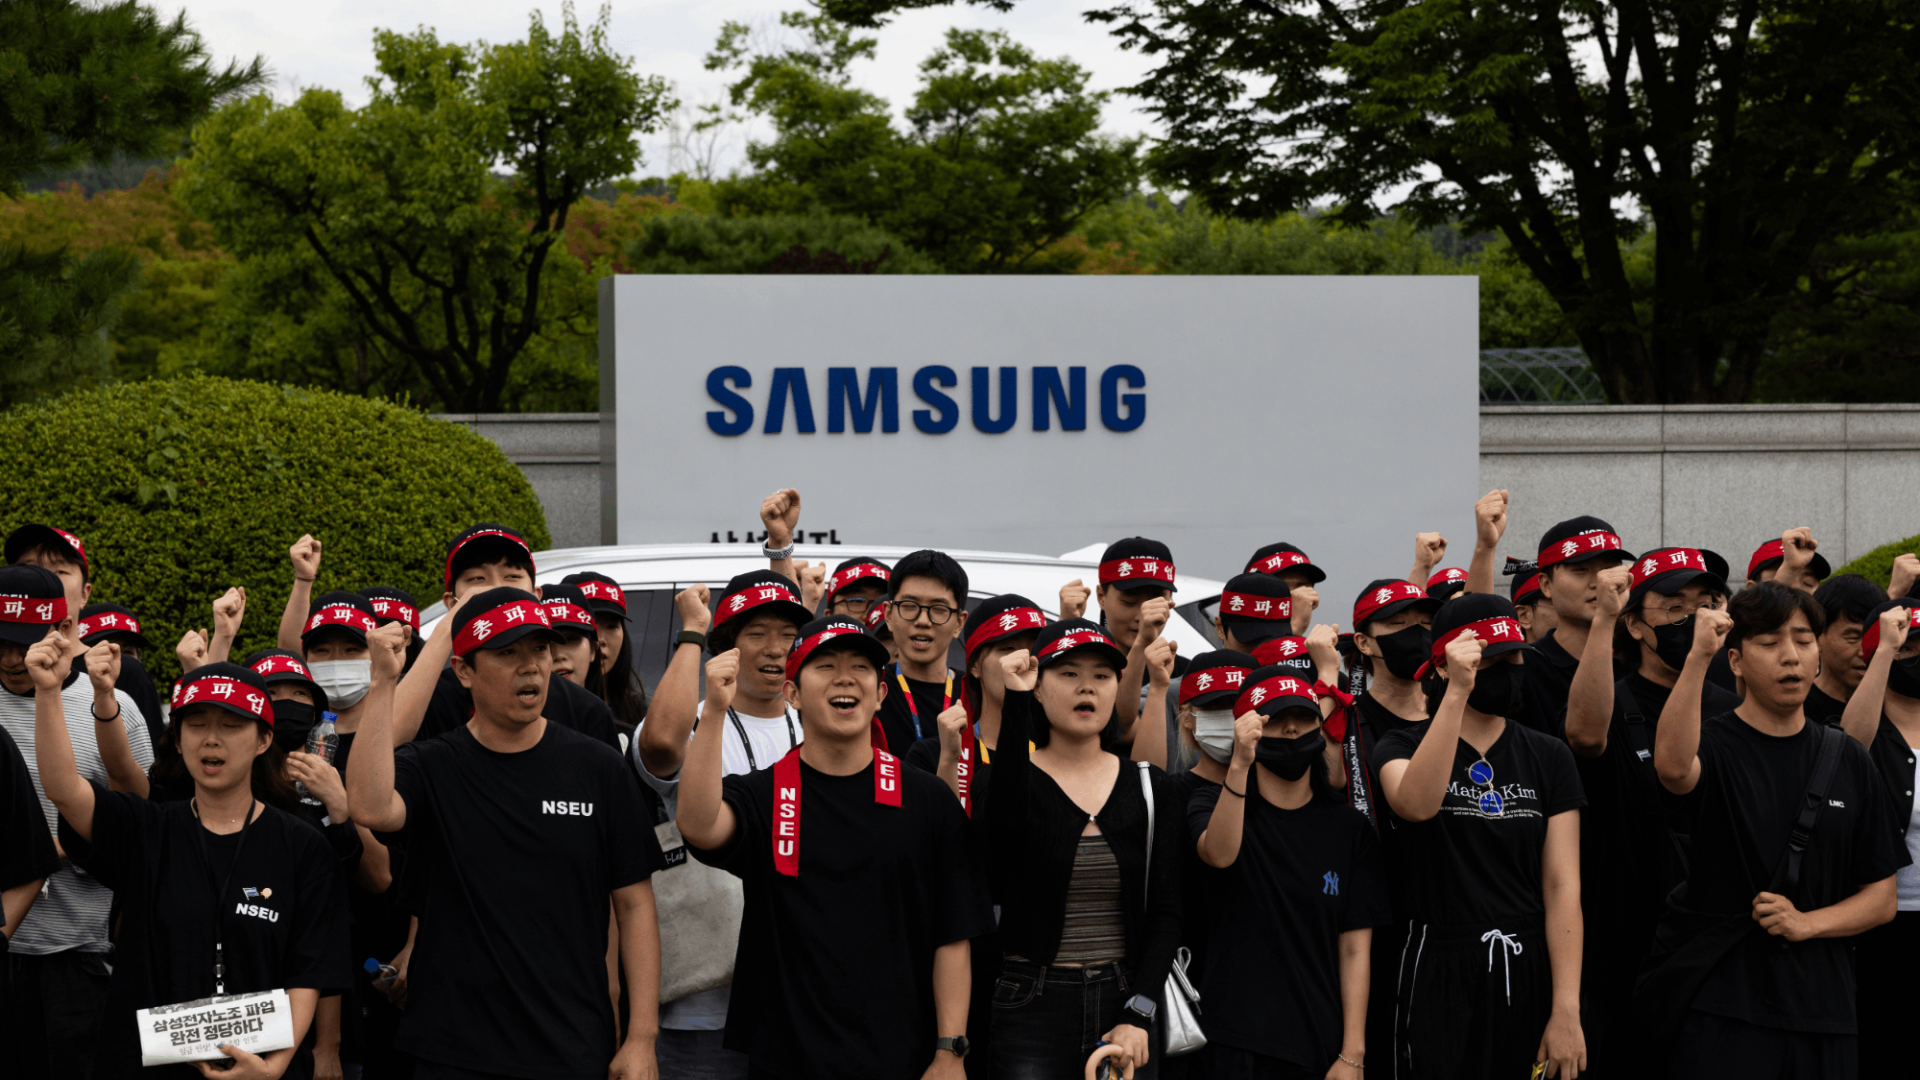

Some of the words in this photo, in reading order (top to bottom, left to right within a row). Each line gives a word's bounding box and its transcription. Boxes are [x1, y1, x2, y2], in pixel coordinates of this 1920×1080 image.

[706, 365, 1146, 435] SAMSUNG
[1117, 561, 1174, 580] 총파업
[1229, 595, 1290, 616] 총파업
[472, 605, 549, 640] 총파업
[1000, 612, 1047, 631] 총파
[183, 682, 265, 715] 총파업
[1500, 783, 1537, 800] Kim
[542, 801, 593, 816] NSEU
[778, 788, 796, 856] NSEU
[236, 902, 279, 923] NSEU
[153, 1007, 242, 1033] 삼성전자노조
[245, 1000, 275, 1017] 파업
[170, 1028, 202, 1046] 완전
[203, 1017, 264, 1040] 정당하다
